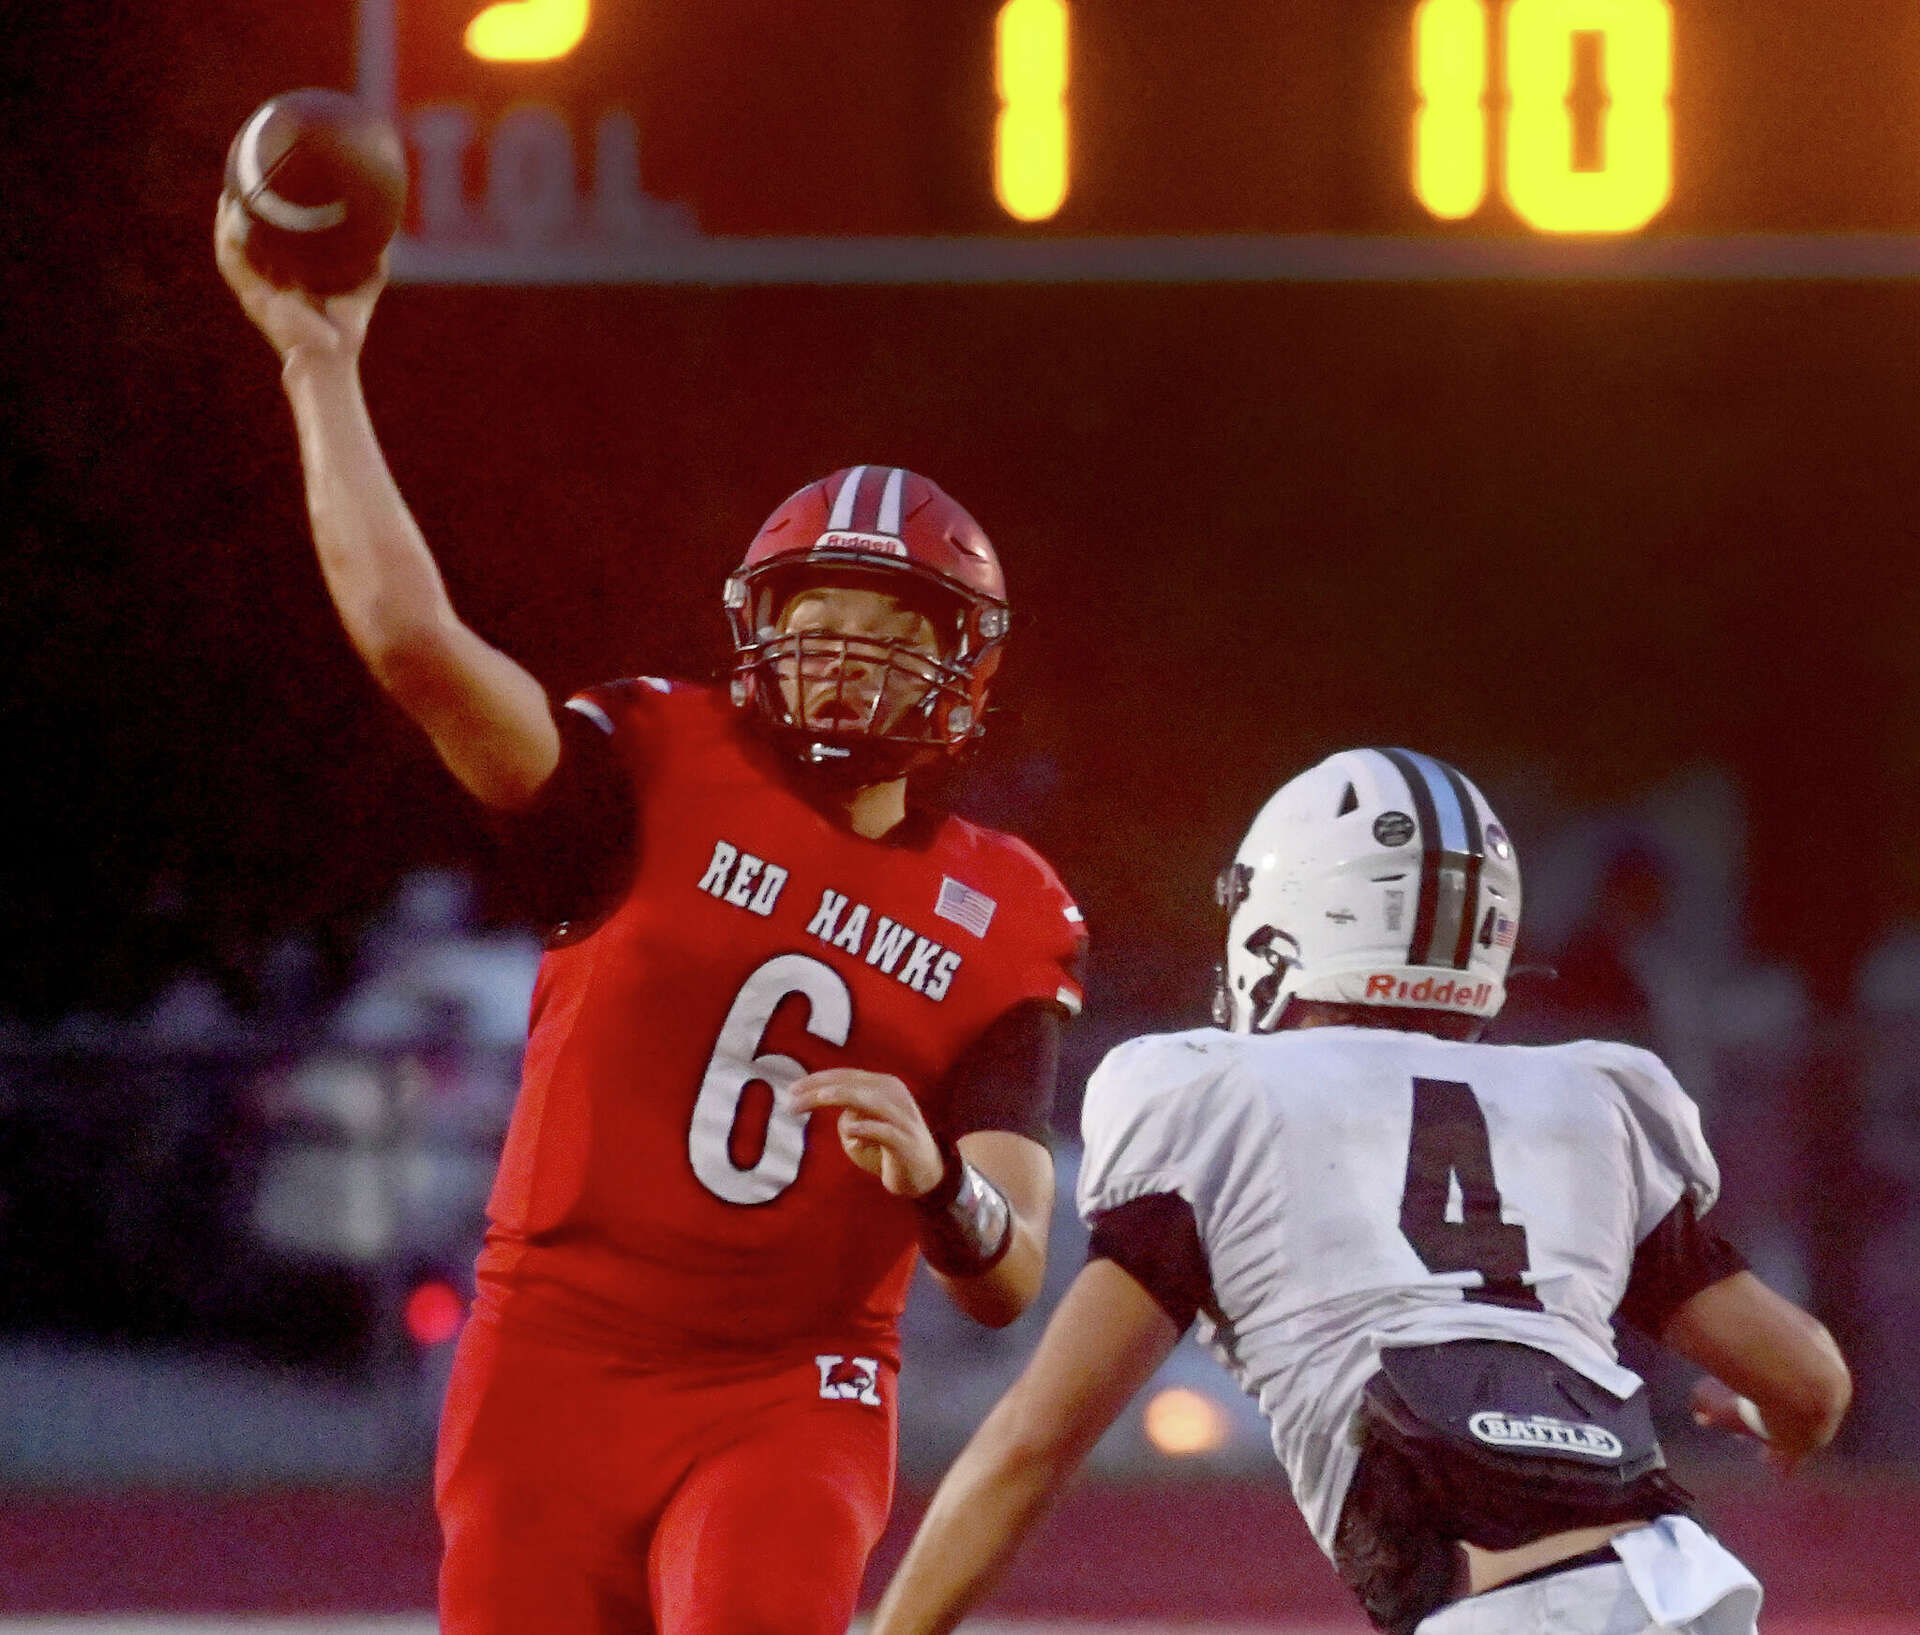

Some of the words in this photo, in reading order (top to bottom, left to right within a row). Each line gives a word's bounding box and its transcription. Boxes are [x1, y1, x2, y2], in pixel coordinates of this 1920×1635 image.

[997, 0, 1068, 222] 1
[1414, 0, 1672, 234] 10
[698, 839, 789, 917] RED
[806, 888, 963, 1002] HAWKS
[1365, 974, 1492, 1010] Riddell
[688, 953, 852, 1205] 6
[1399, 1076, 1545, 1313] 4
[1479, 1419, 1614, 1452] BATTLE
